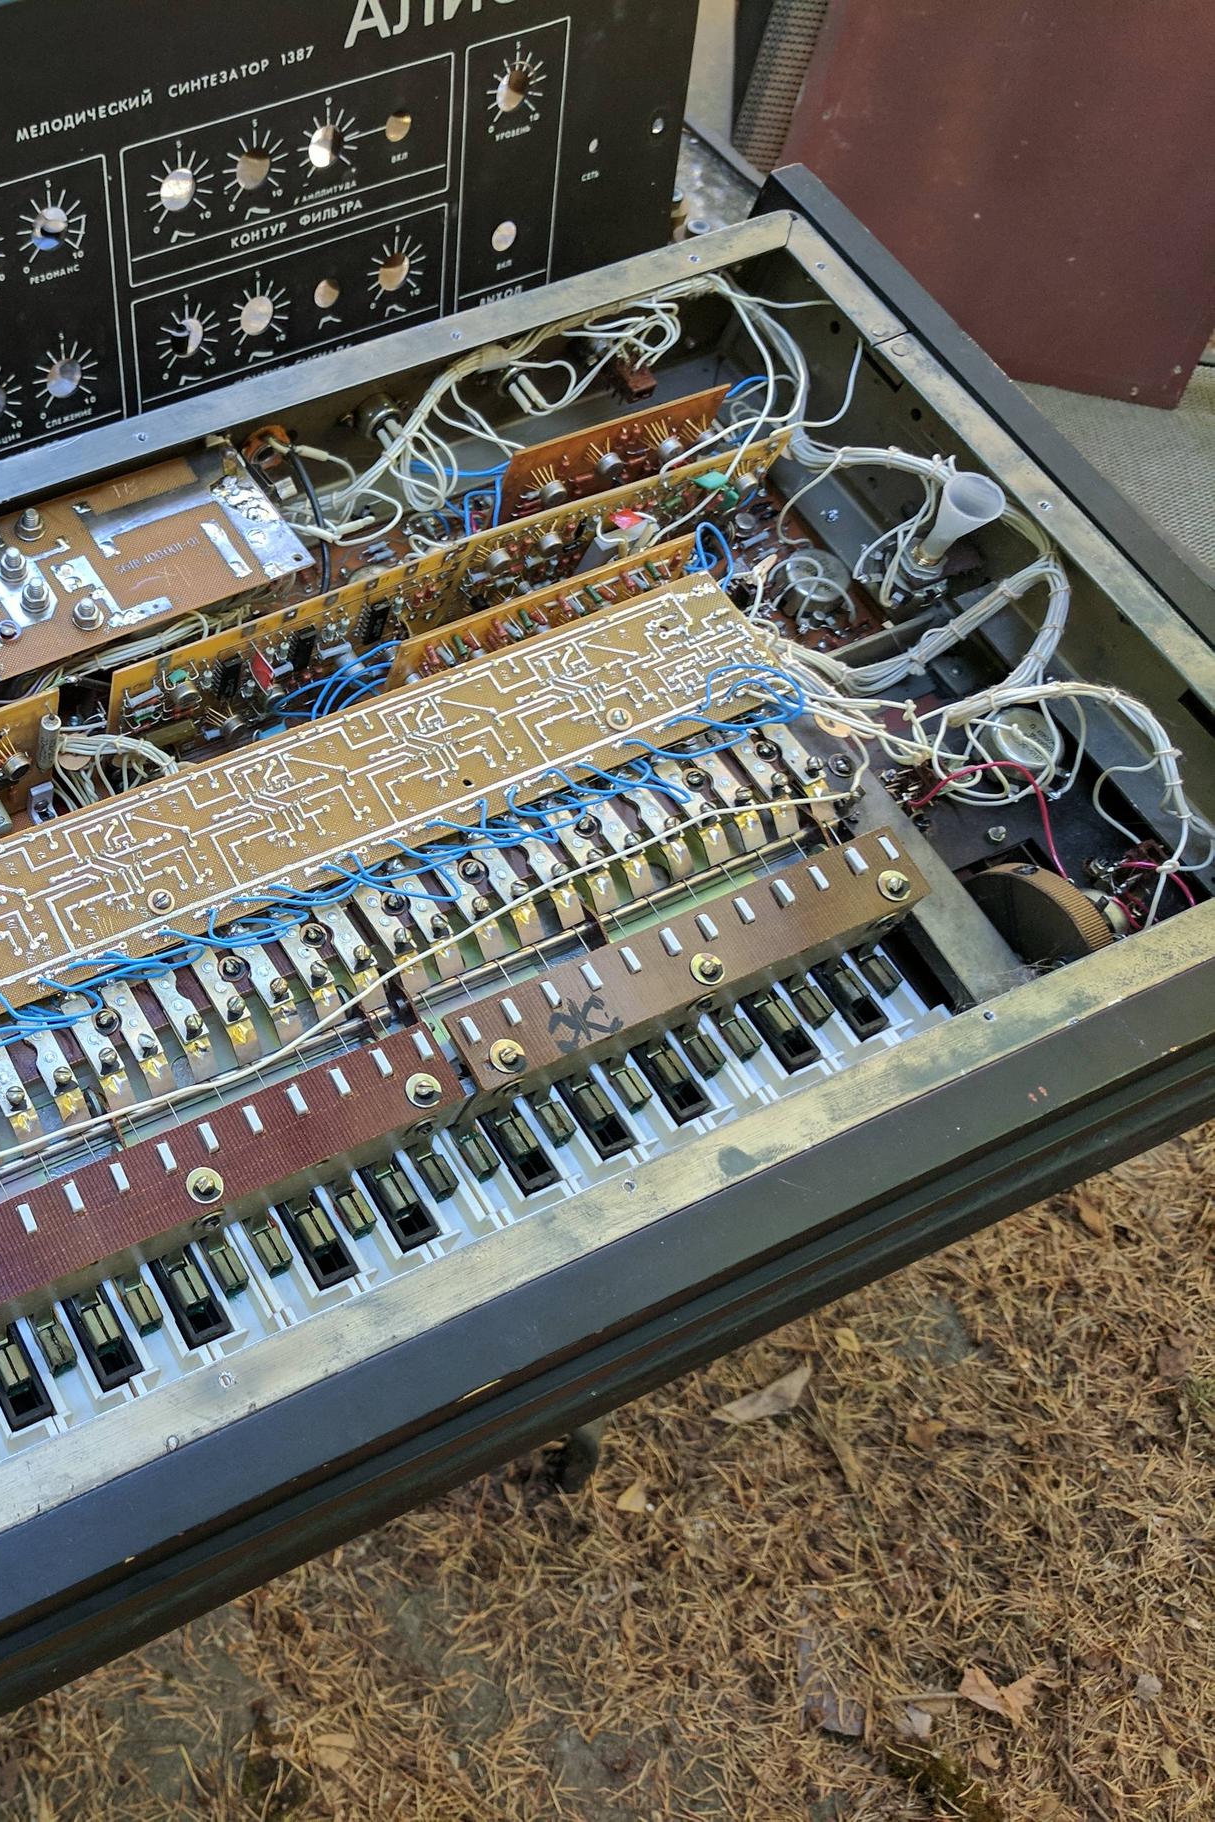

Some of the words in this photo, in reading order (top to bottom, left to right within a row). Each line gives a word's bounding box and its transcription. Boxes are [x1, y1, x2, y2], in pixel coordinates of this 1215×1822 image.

[15, 88, 154, 142] МЕЛОДИЧЕСКИЙ
[168, 58, 271, 98] СИНТЕЗАТОР
[279, 45, 314, 67] 1387
[45, 180, 51, 188] 5
[302, 180, 357, 202] АМПЛИТУДА
[231, 221, 288, 248] КОНТУР
[298, 200, 363, 226] ФИЛЬТРА
[72, 250, 84, 259] 10
[23, 266, 30, 274] 0
[29, 264, 80, 286] РЕЗОНАНС
